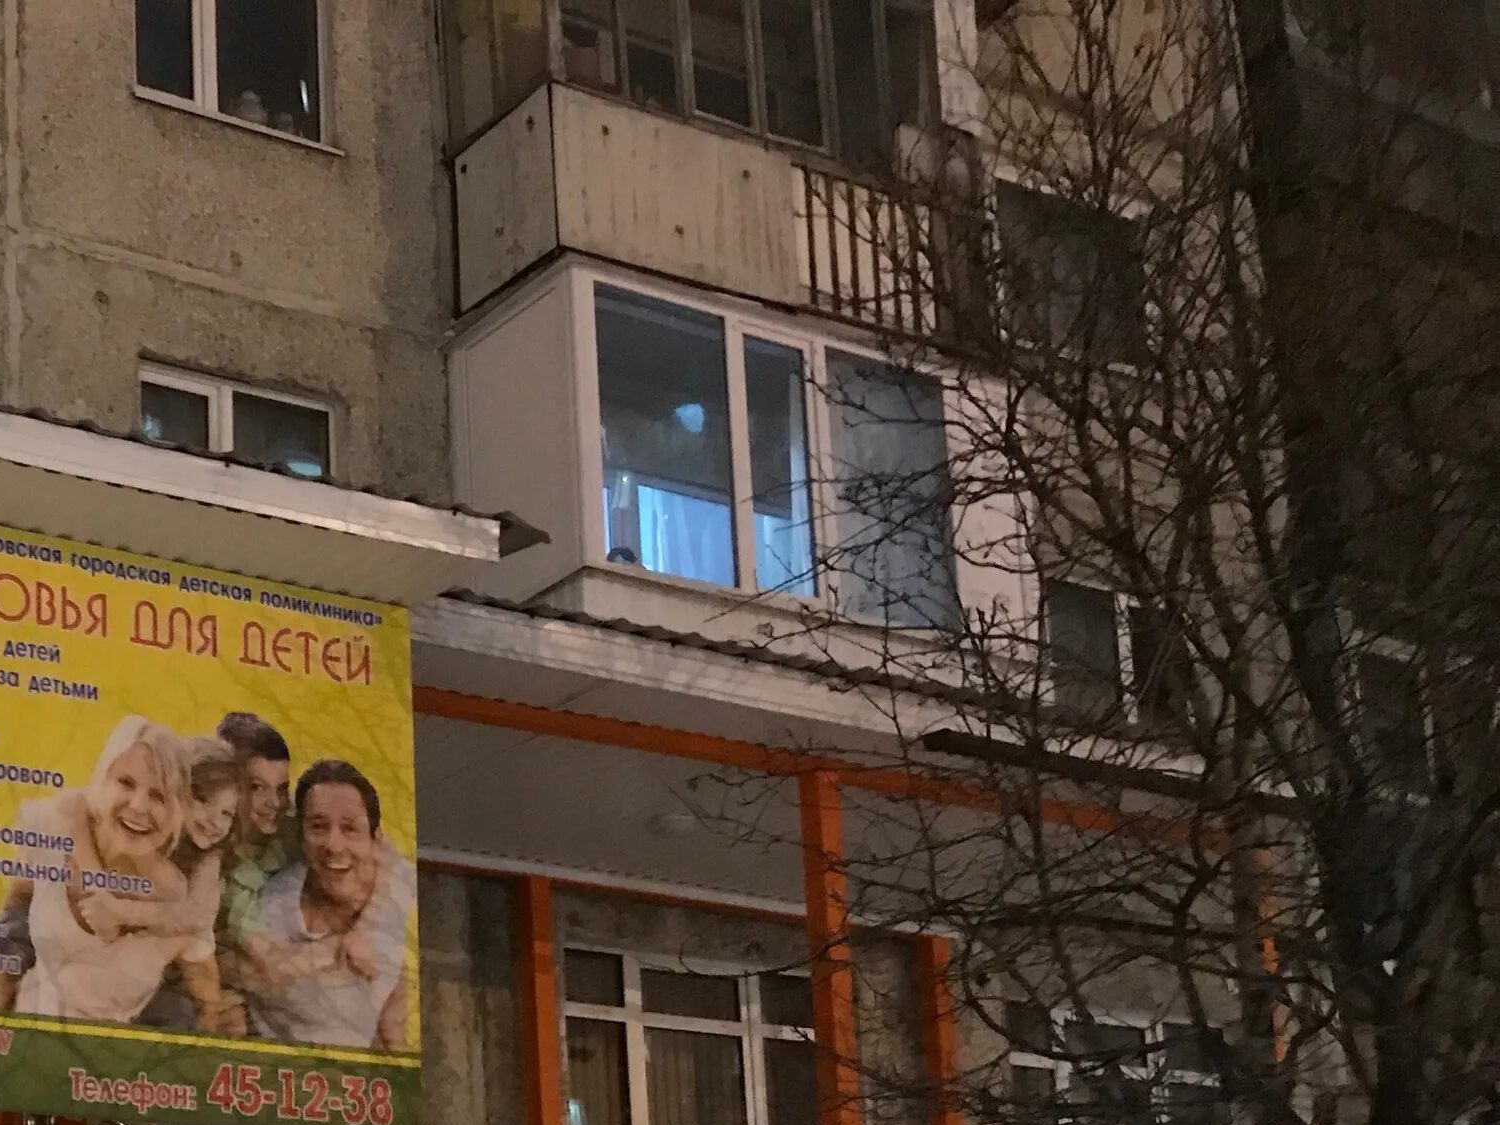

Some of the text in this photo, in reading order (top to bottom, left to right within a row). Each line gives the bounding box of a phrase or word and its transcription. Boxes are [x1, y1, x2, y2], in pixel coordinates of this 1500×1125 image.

[71, 552, 170, 586] городская
[179, 573, 252, 602] детская
[261, 591, 382, 626] поликлиника»
[4, 640, 60, 663] детей
[130, 600, 217, 658] ДЛЯ
[240, 621, 370, 686] ДЕТЕЙ
[28, 676, 98, 701] детьми
[82, 868, 153, 894] работе
[69, 1067, 197, 1114] Телефон:
